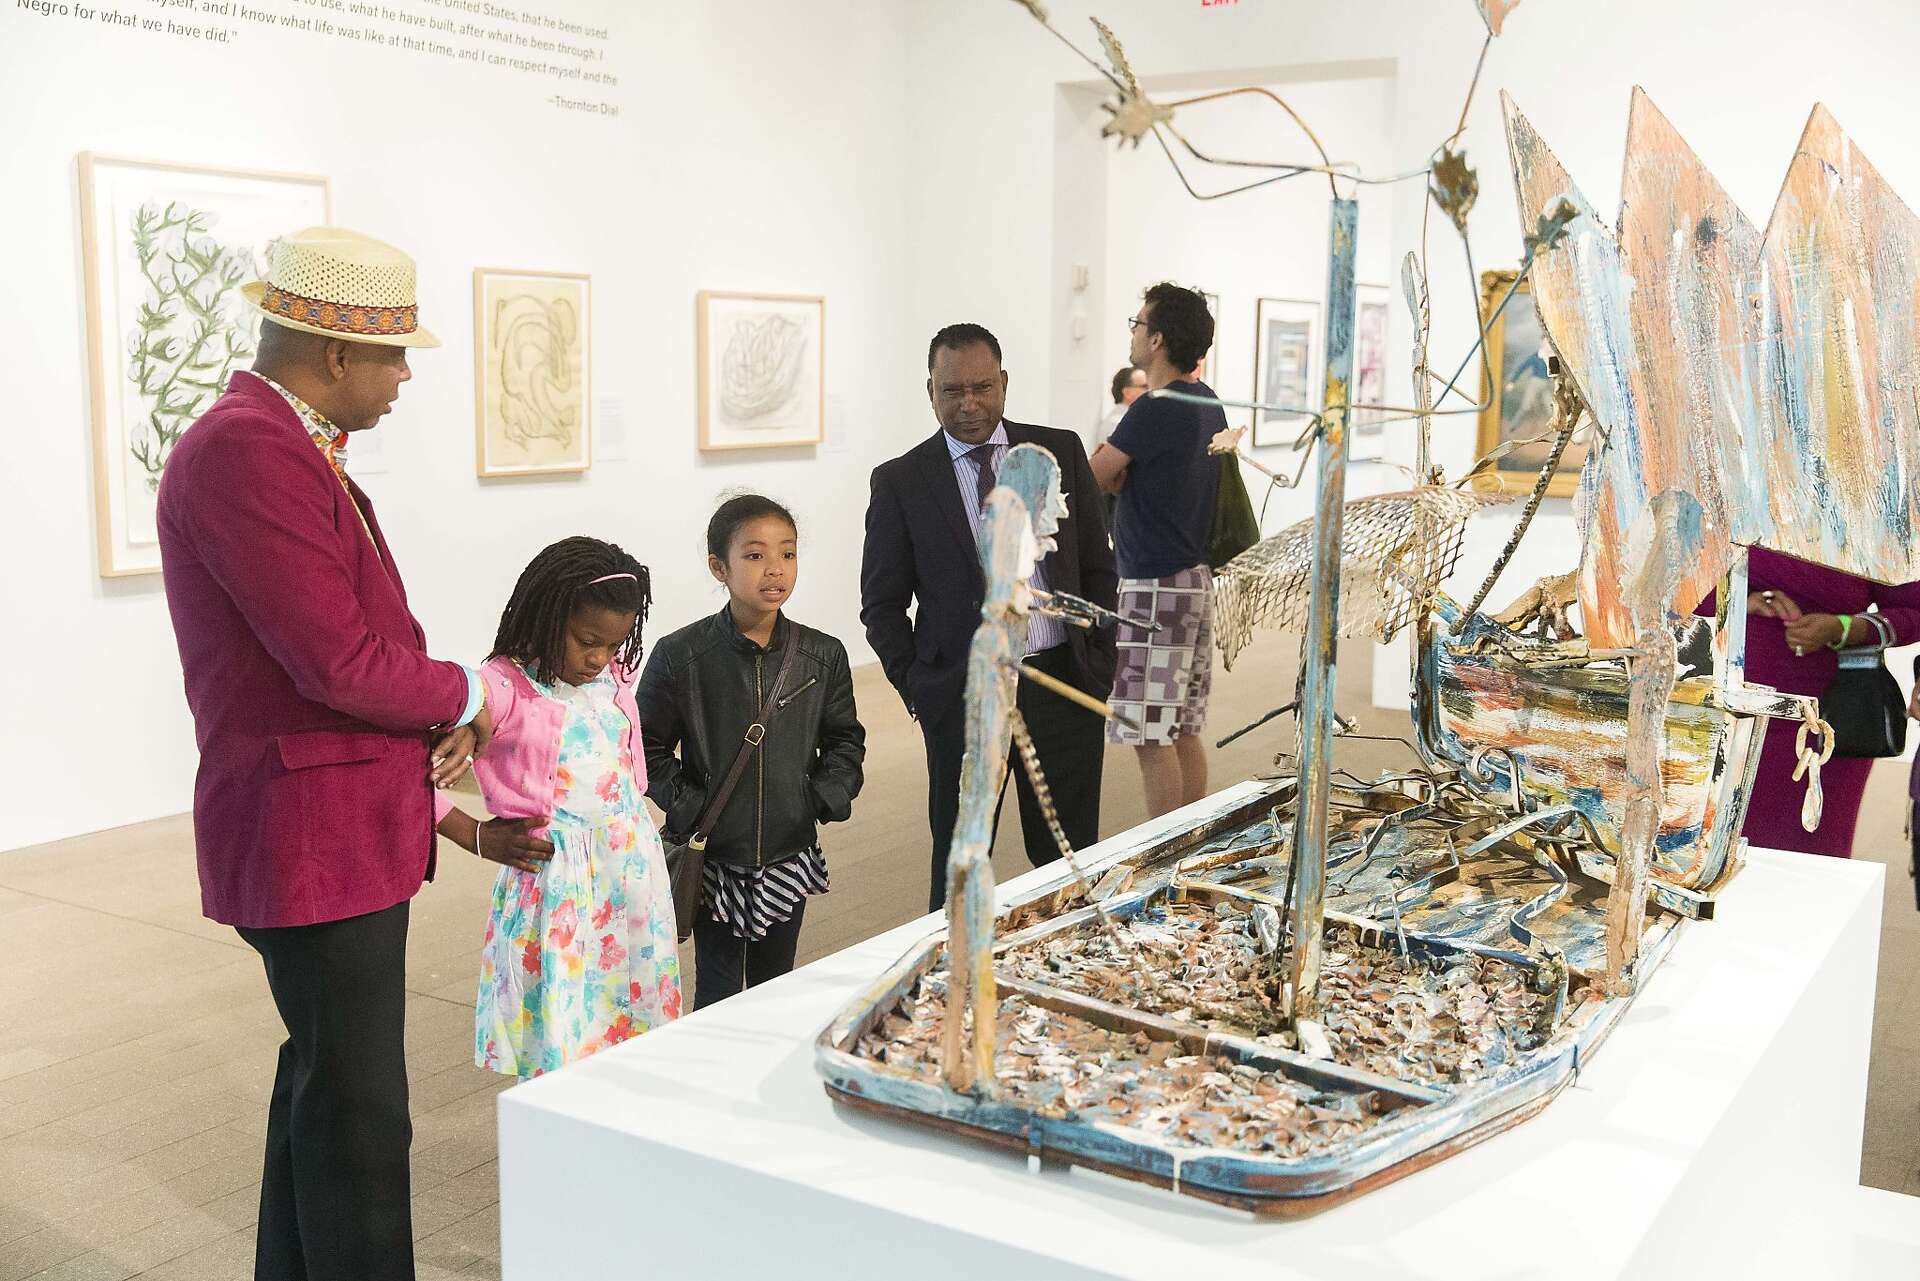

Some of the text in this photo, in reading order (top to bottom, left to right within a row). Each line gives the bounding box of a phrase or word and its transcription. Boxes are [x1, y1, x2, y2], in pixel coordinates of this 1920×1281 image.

[17, 0, 68, 16] Negro
[74, 3, 96, 20] for
[100, 10, 137, 27] what
[142, 18, 162, 31] we
[167, 19, 201, 38] have
[350, 2, 378, 17] what
[382, 6, 396, 21] he
[399, 10, 426, 26] have
[460, 23, 484, 37] after
[488, 29, 513, 44] what
[516, 33, 528, 47] he
[530, 36, 555, 52] been
[599, 48, 603, 60] I
[445, 0, 480, 12] United
[522, 12, 541, 26] that
[544, 16, 556, 29] he
[559, 19, 582, 34] been
[202, 2, 229, 15] and
[233, 3, 238, 17] I
[241, 5, 277, 23] know
[281, 15, 310, 31] what
[315, 19, 334, 34] life
[338, 27, 362, 40] was
[364, 28, 385, 44] like
[388, 34, 400, 47] at
[403, 35, 425, 51] that
[428, 41, 456, 58] time,
[458, 47, 478, 61] and
[481, 50, 485, 61] I
[488, 53, 506, 65] can
[508, 57, 547, 73] respect
[549, 65, 581, 80] myself
[583, 70, 601, 83] and
[603, 73, 617, 86] the
[600, 102, 619, 116] Dial
